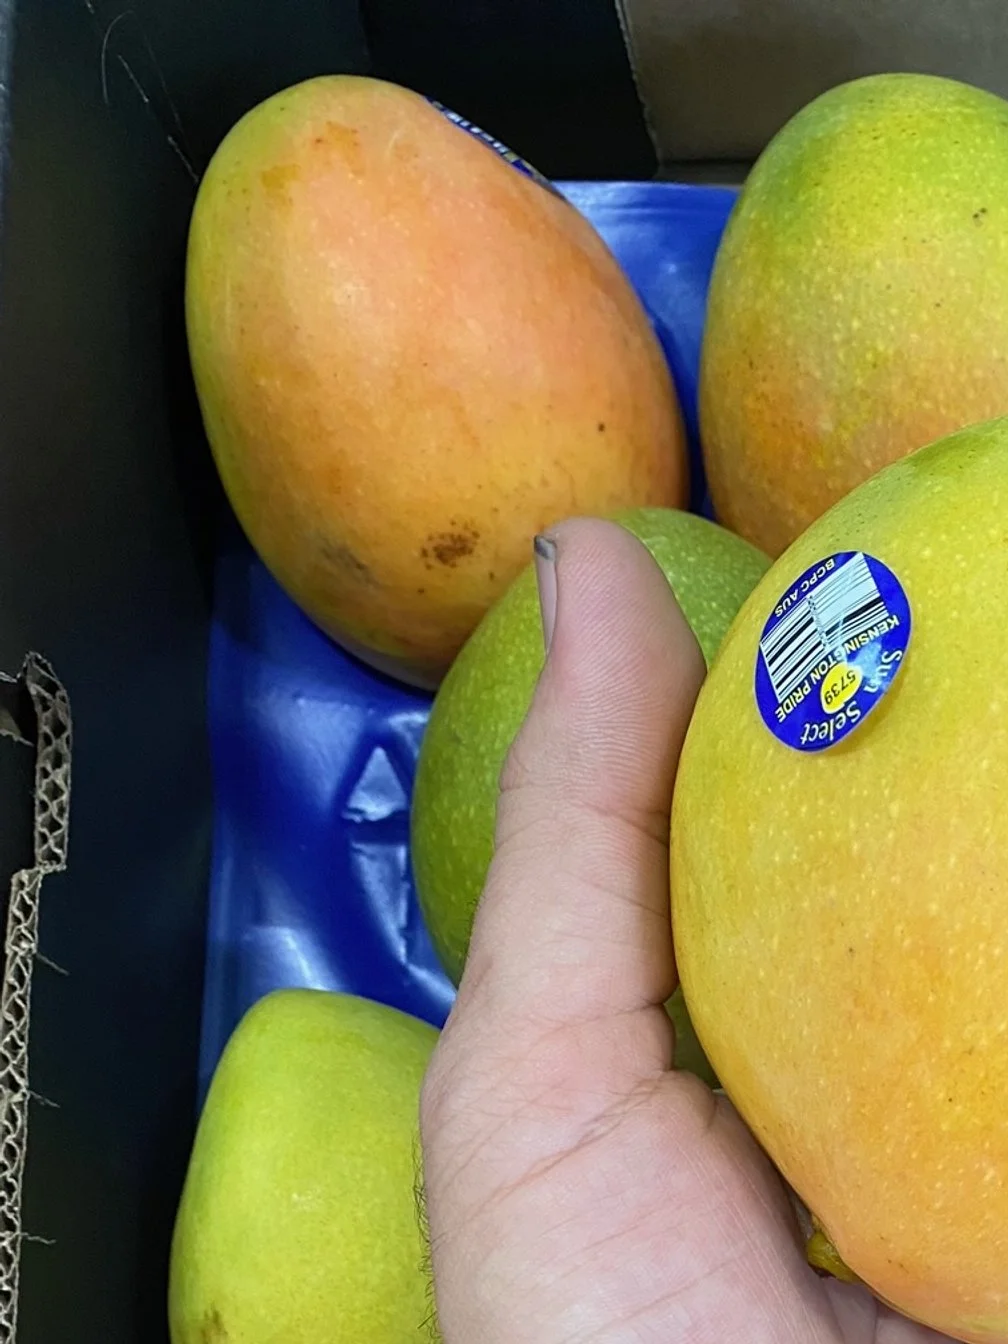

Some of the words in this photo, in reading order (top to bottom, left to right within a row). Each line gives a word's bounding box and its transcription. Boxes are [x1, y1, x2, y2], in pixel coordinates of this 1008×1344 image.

[801, 558, 835, 591] BCPC
[775, 592, 802, 617] AUS
[811, 615, 900, 684] KENSINGTON
[825, 670, 857, 705] 5739
[864, 649, 903, 694] Sun
[775, 685, 812, 723] PRIDE
[800, 700, 861, 745] Select
